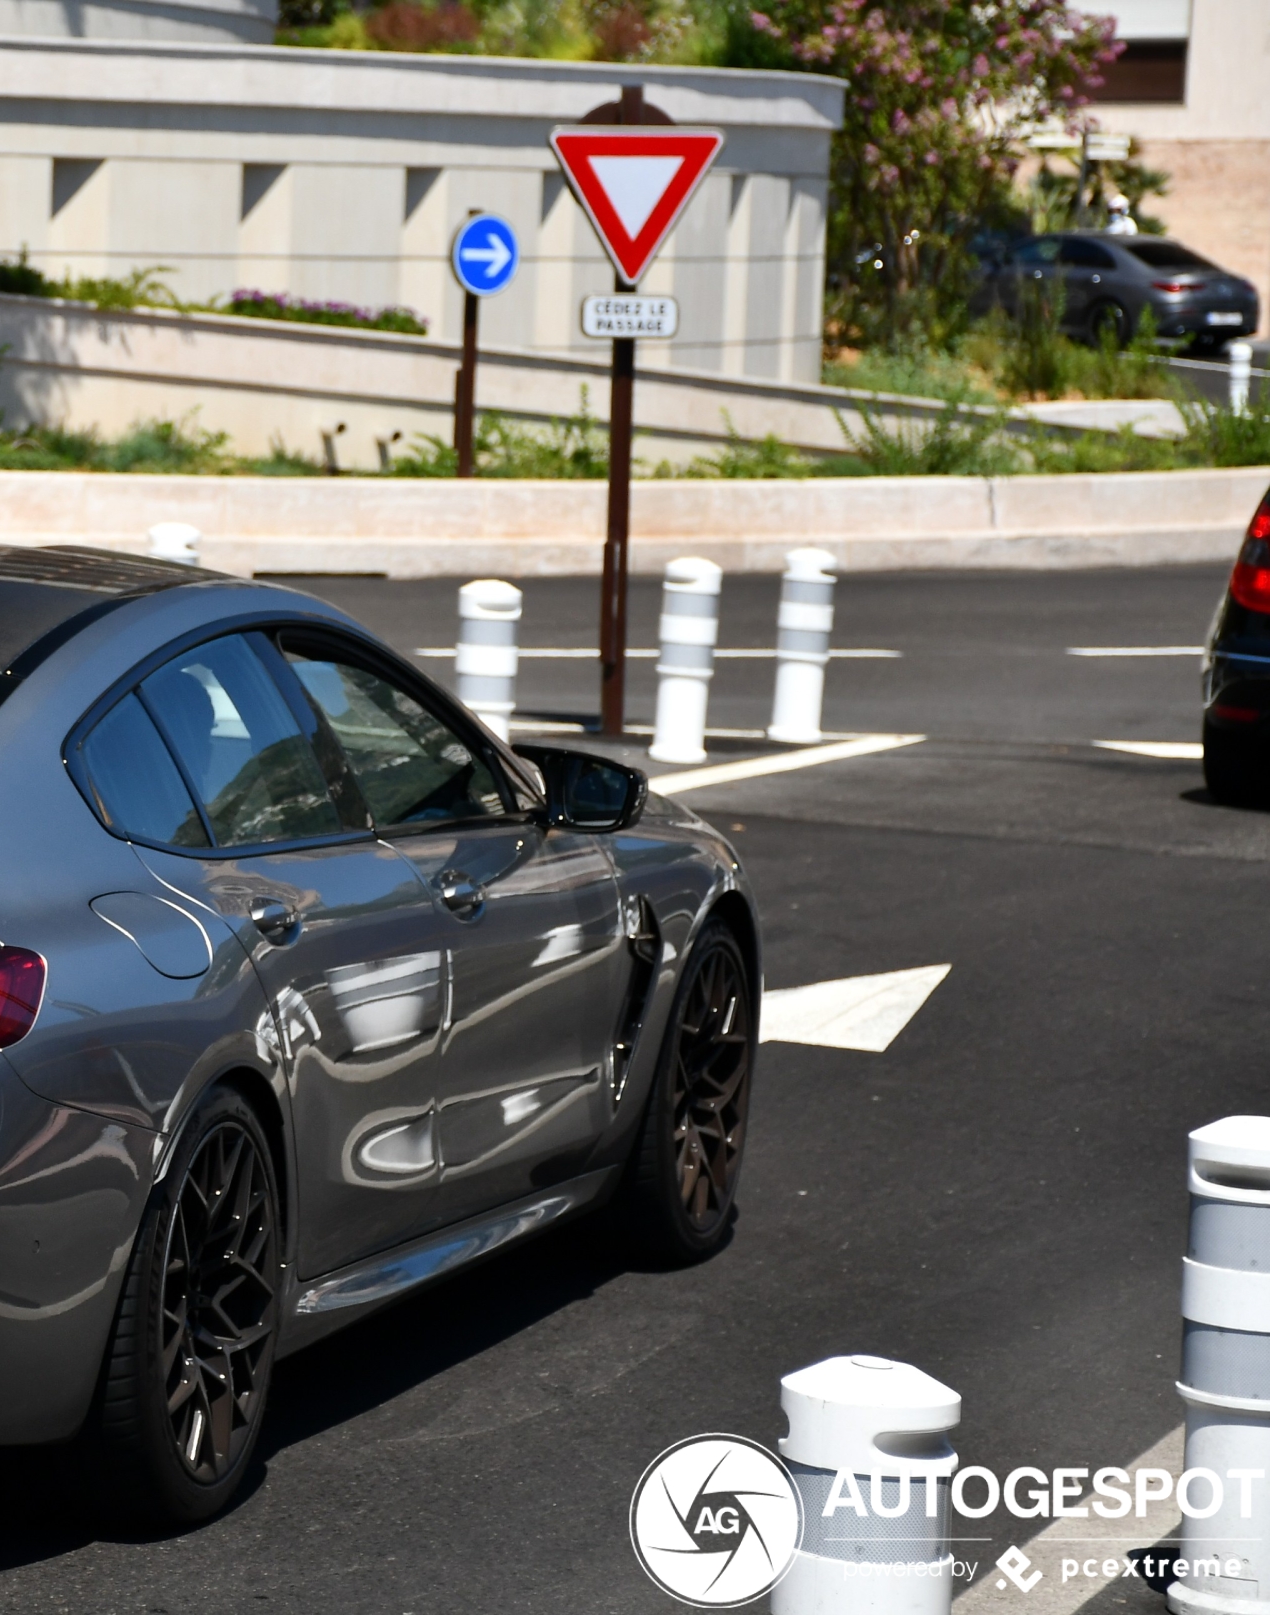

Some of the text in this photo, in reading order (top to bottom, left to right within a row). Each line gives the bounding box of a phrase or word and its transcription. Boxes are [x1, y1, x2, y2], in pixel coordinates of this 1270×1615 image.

[596, 300, 665, 314] CÉDEZ LE
[596, 320, 662, 331] PASSAGE
